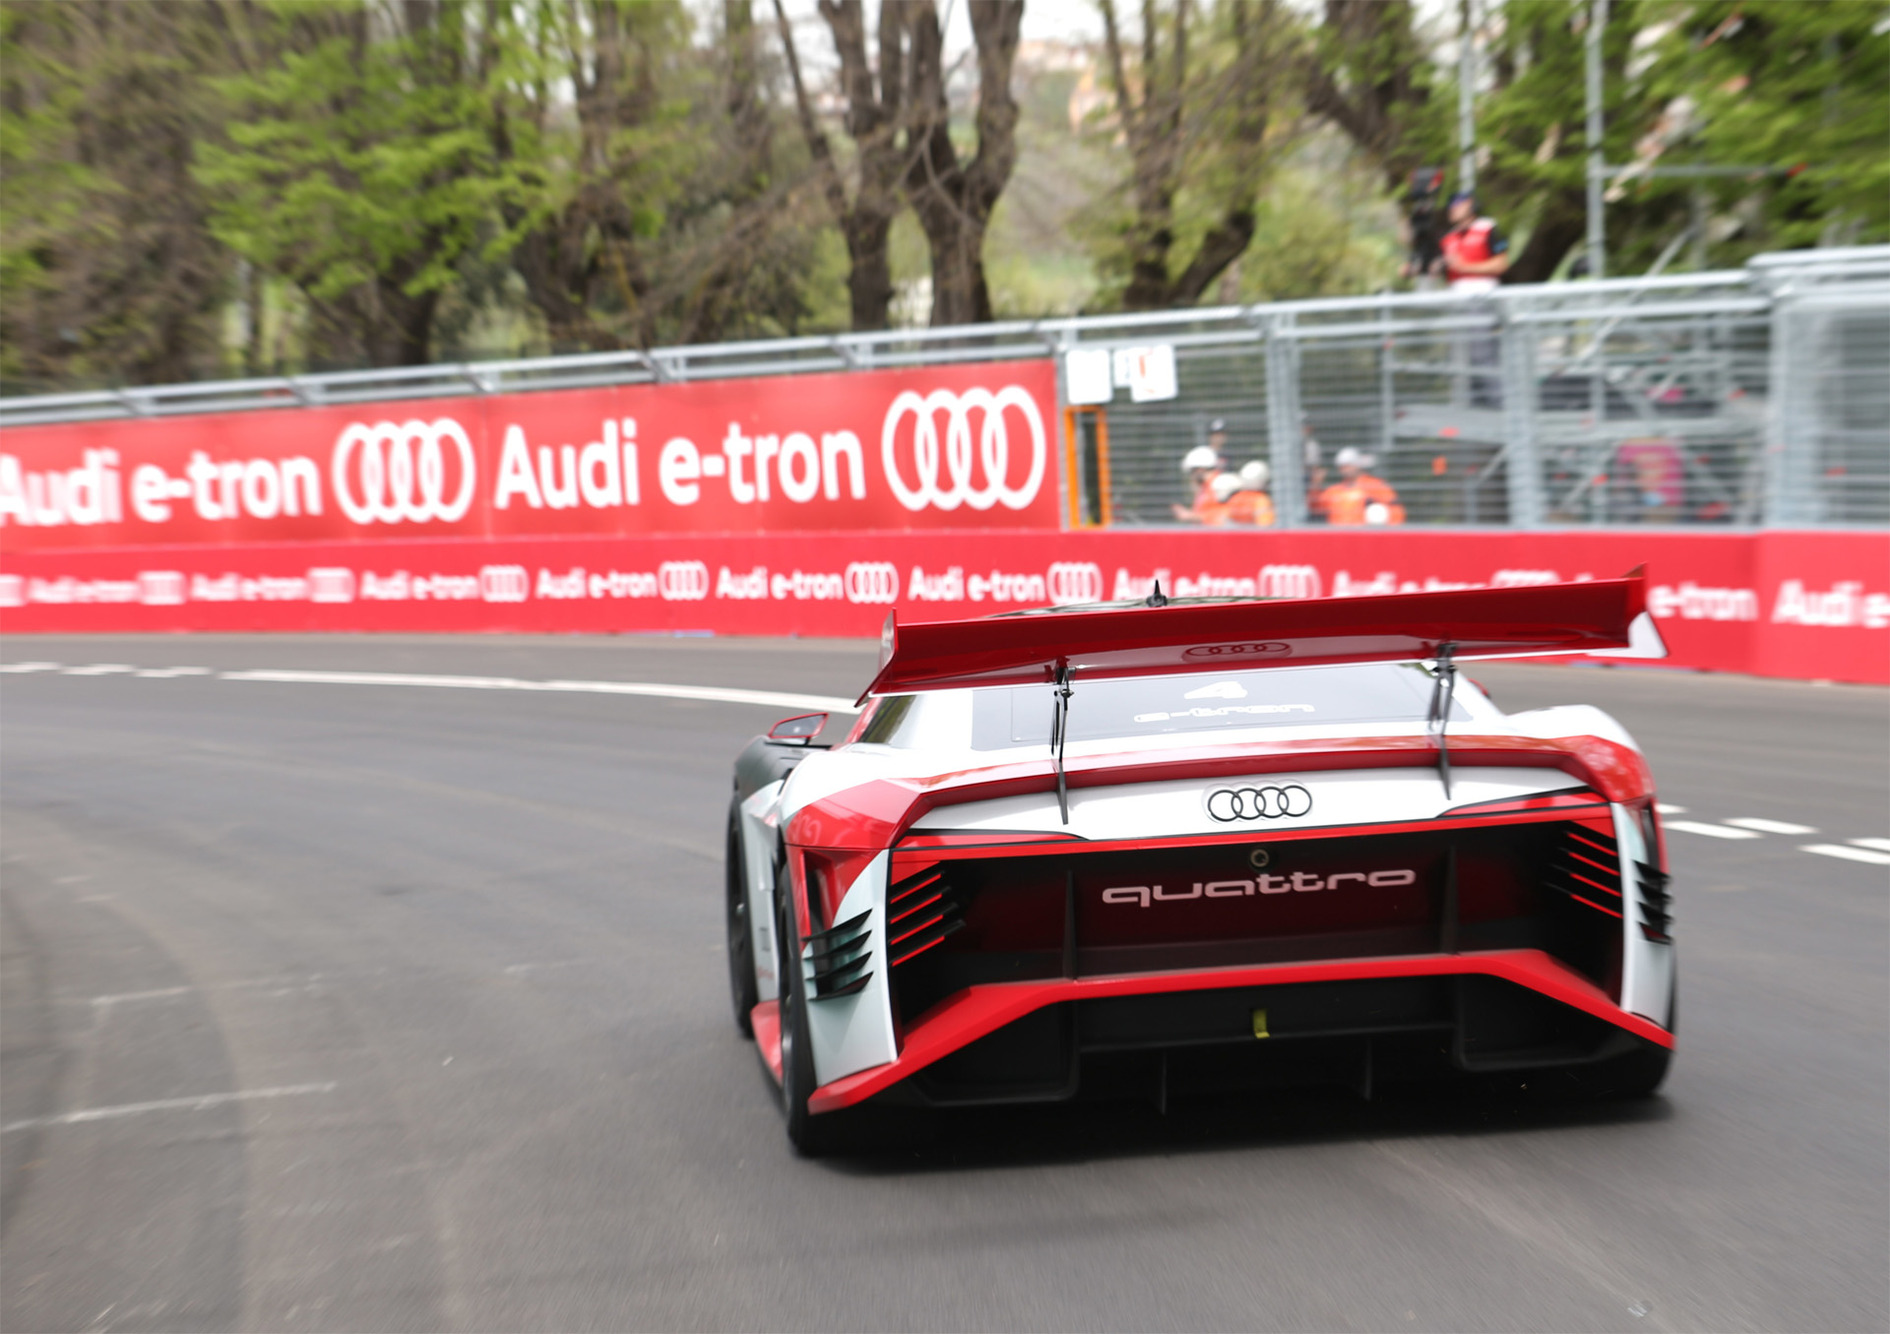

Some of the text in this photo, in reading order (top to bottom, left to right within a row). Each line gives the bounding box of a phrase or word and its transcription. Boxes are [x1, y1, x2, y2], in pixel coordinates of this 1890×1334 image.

[493, 416, 868, 510] Audi e-tron
[0, 447, 323, 527] Audi e-tron
[360, 569, 478, 601] Audi e-tron
[535, 567, 657, 600] Audi e-tron
[715, 566, 844, 601] Audi e-tron
[907, 565, 1046, 603] Audi e-tron
[1112, 567, 1170, 601] Audi
[1770, 579, 1864, 627] Audi
[1133, 704, 1315, 722] e-tron
[1102, 869, 1416, 907] quattro
